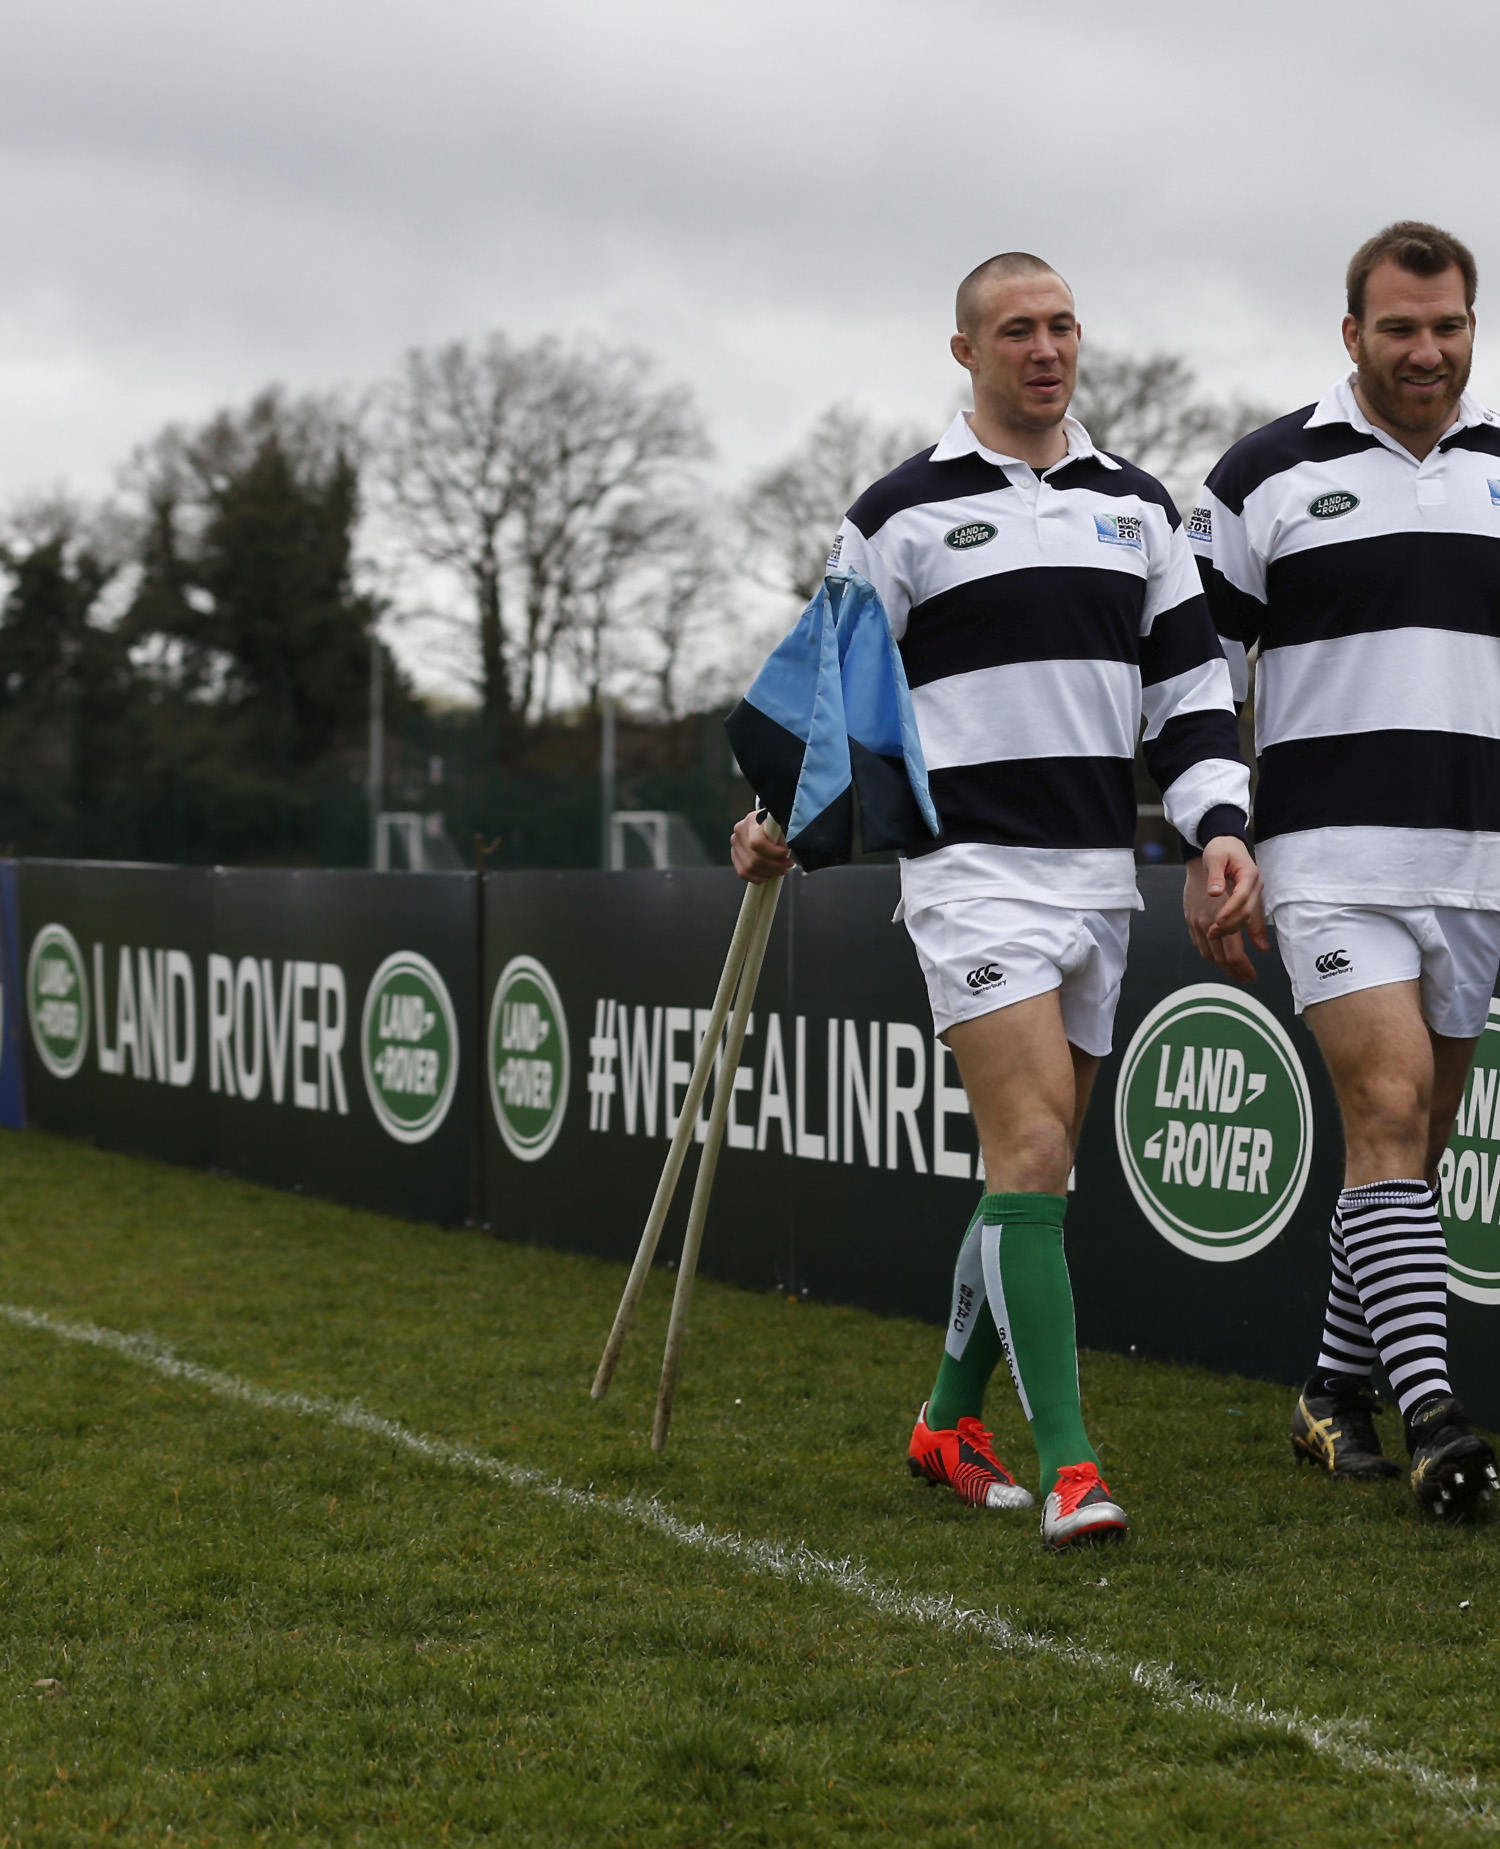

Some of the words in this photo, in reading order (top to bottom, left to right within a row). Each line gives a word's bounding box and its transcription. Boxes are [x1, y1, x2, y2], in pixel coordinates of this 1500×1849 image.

[1193, 507, 1212, 518] RUGB
[1317, 496, 1341, 508] LAND
[1322, 501, 1351, 515] ROVER
[955, 526, 979, 539] LAND
[959, 531, 989, 546] ROVER
[93, 942, 196, 1087] LAND
[208, 953, 349, 1115] ROVER
[379, 993, 425, 1043] LAND
[501, 1001, 541, 1053] LAND
[381, 1045, 439, 1097] ROVER
[503, 1057, 553, 1110] ROVER
[587, 998, 1076, 1192] #WEDEALINRE
[1155, 1044, 1245, 1114] LAND
[1162, 1119, 1273, 1195] ROVER
